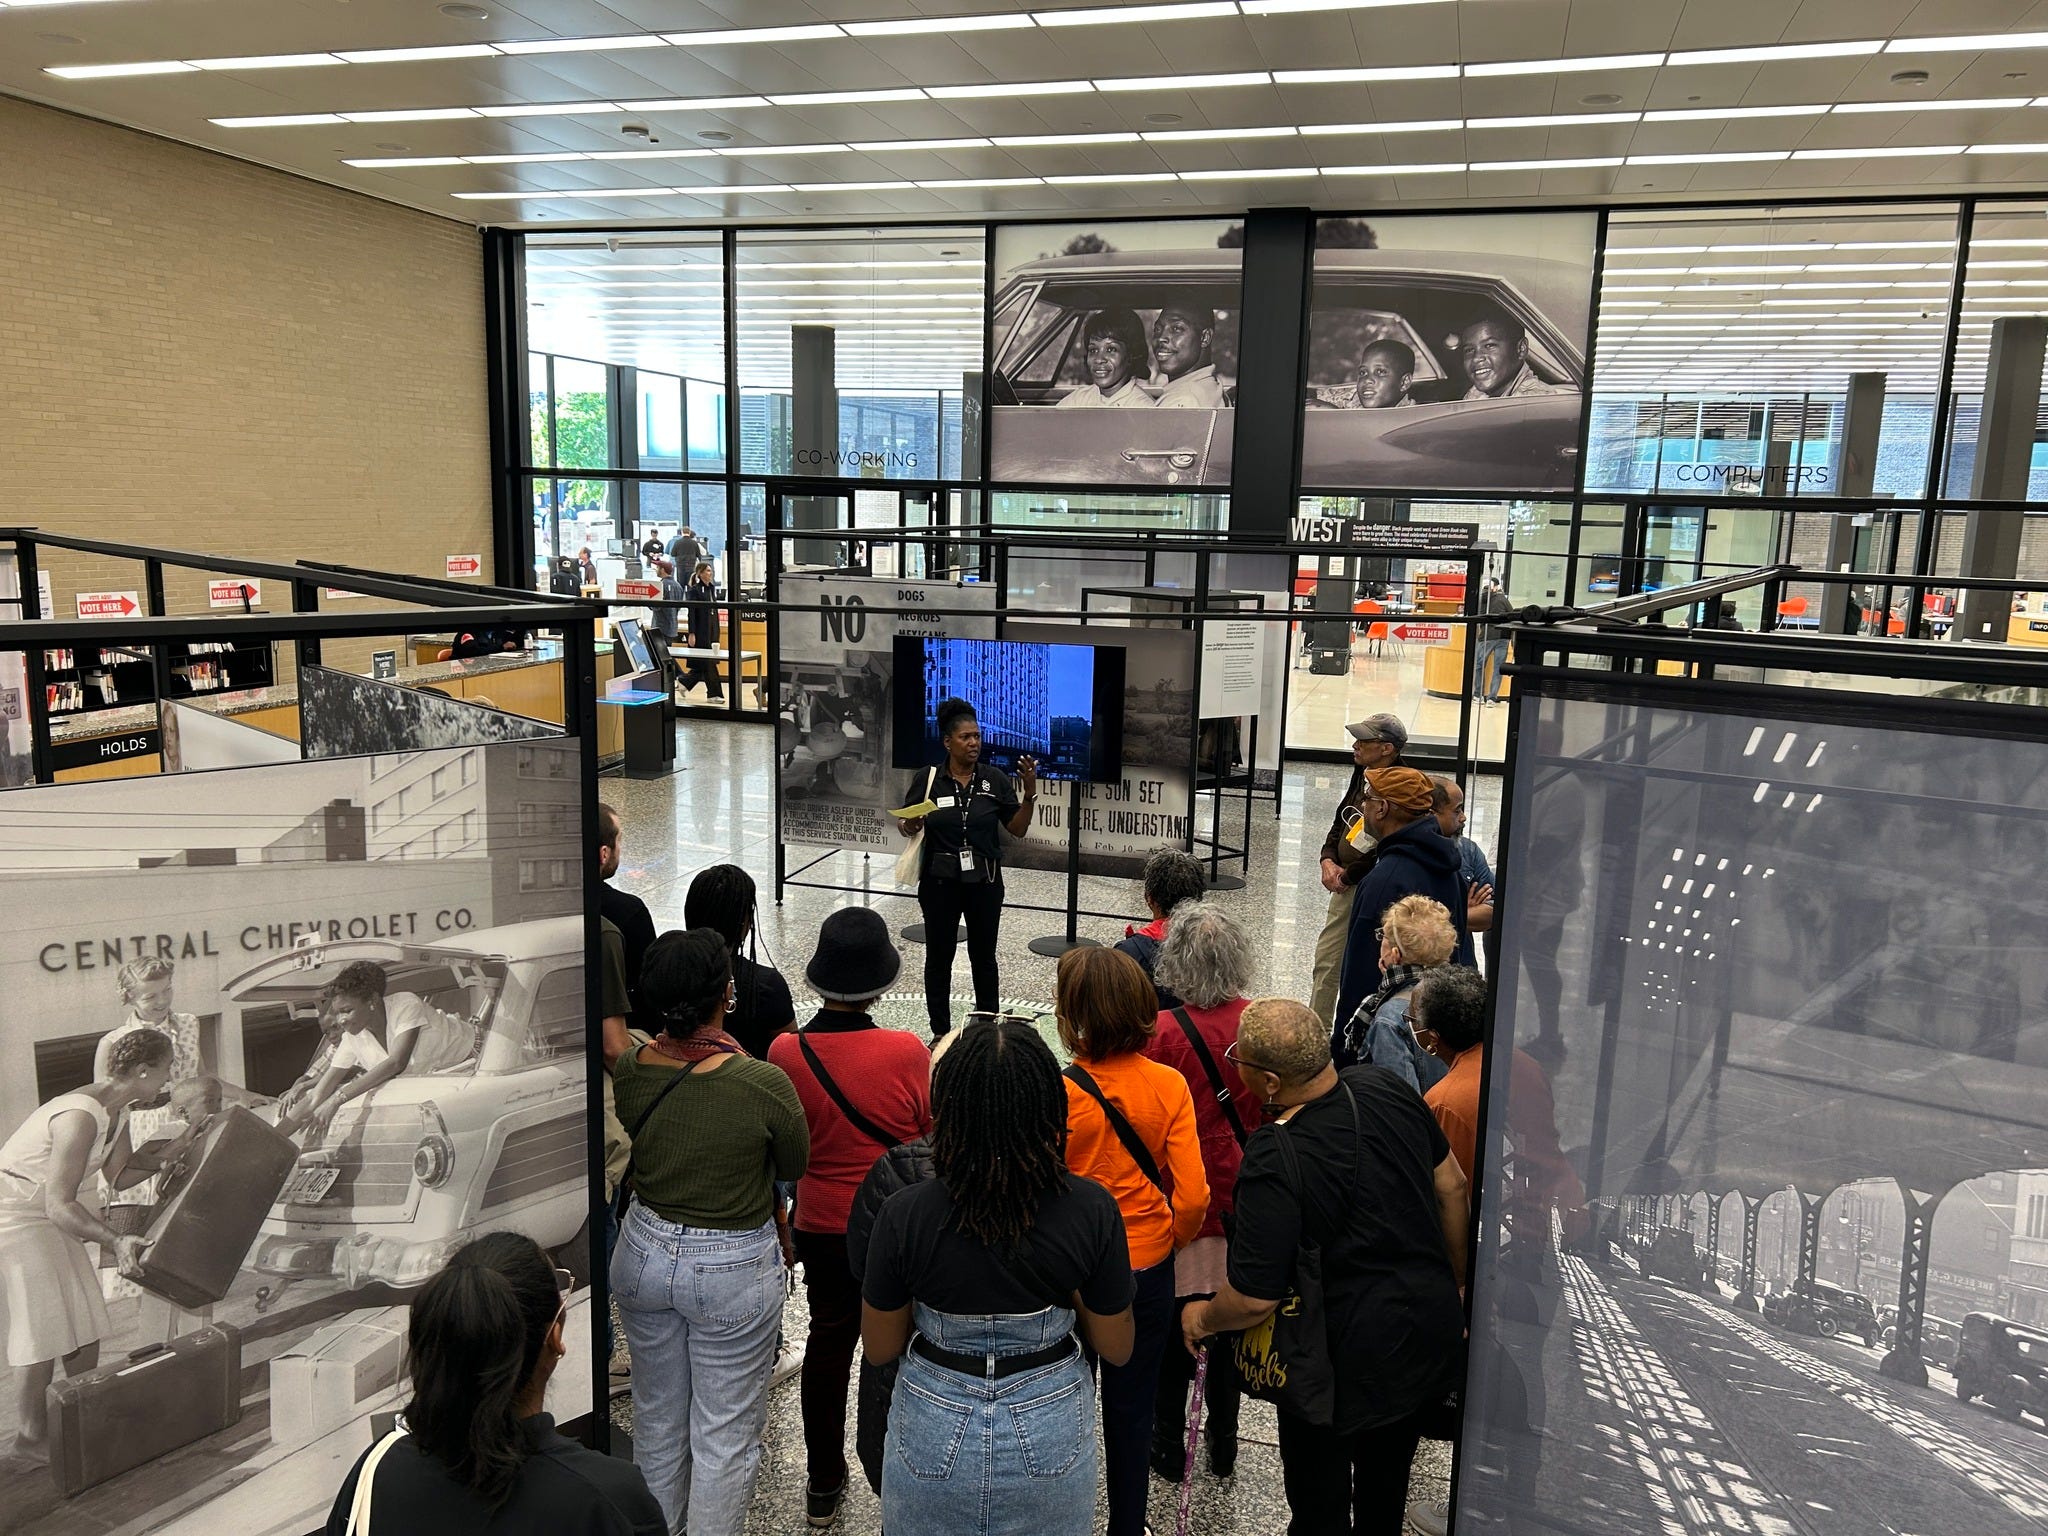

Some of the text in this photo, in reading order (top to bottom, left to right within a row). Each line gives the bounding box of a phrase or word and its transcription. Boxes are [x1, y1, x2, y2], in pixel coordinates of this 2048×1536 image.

[797, 449, 918, 468] CO-WORKING
[1676, 464, 1828, 484] COMPUTERS
[1291, 517, 1346, 543] WEST
[212, 589, 243, 599] VOTE HER
[618, 586, 649, 595] VOTE HERE
[81, 602, 122, 613] VOTE HERE
[820, 590, 925, 644] NO DOGS
[1406, 629, 1448, 638] VOTE HERE
[100, 737, 147, 756] HOLDS
[1081, 782, 1097, 799] HE
[1139, 780, 1164, 804] SET
[830, 806, 854, 816] ASLEEP
[783, 819, 882, 836] ACCOMMODATIONS FOR NEGROES
[812, 812, 831, 822] THERE
[832, 815, 846, 824] ARE
[846, 816, 854, 825] NO
[855, 817, 885, 828] SLEEPING
[1039, 803, 1061, 828] YOU
[1108, 810, 1188, 840] UNDERSTAND
[783, 827, 790, 835] AT
[792, 828, 805, 837] THIS
[806, 829, 832, 840] SERVICE
[1094, 841, 1114, 852] Feb
[39, 907, 477, 972] CENTRAL CHEVROLET CO.
